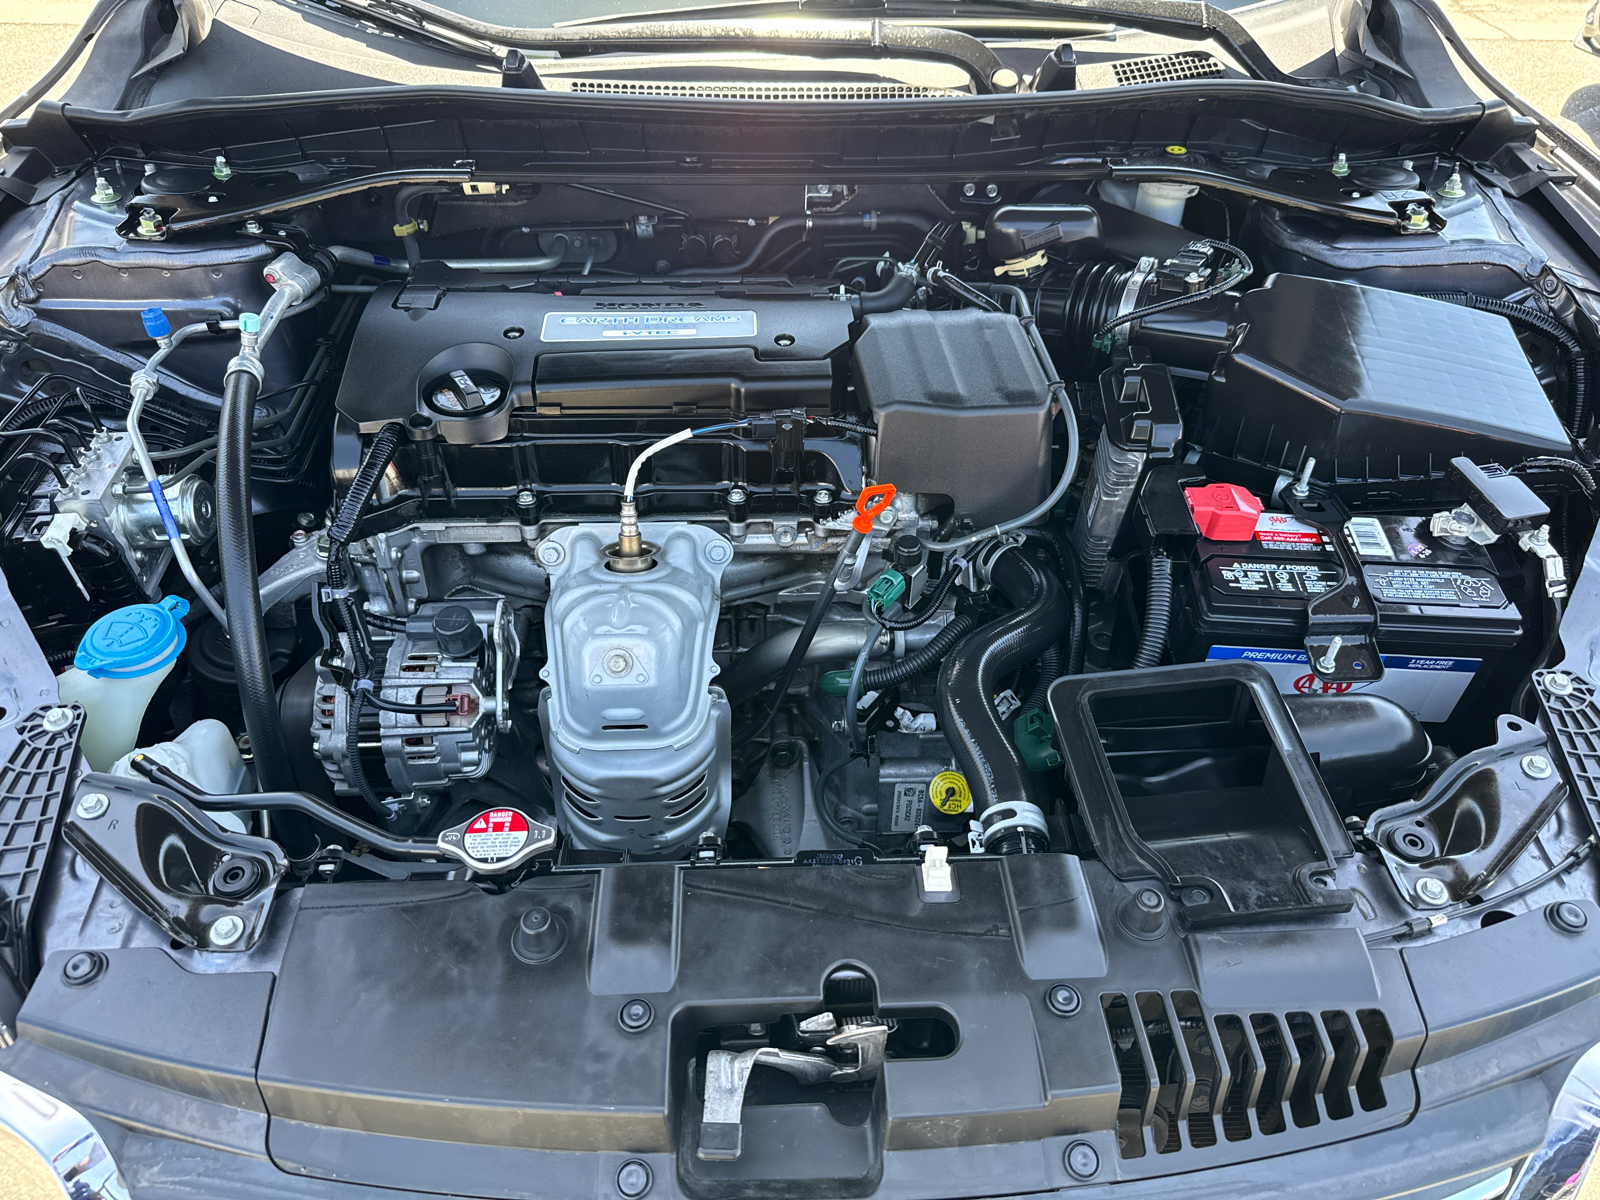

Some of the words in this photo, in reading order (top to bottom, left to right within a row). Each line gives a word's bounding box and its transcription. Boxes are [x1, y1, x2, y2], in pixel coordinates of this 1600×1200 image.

[593, 302, 708, 310] HONDA
[559, 316, 640, 325] EARTH
[643, 314, 742, 324] DREAMS
[1242, 651, 1296, 660] PREMIUM
